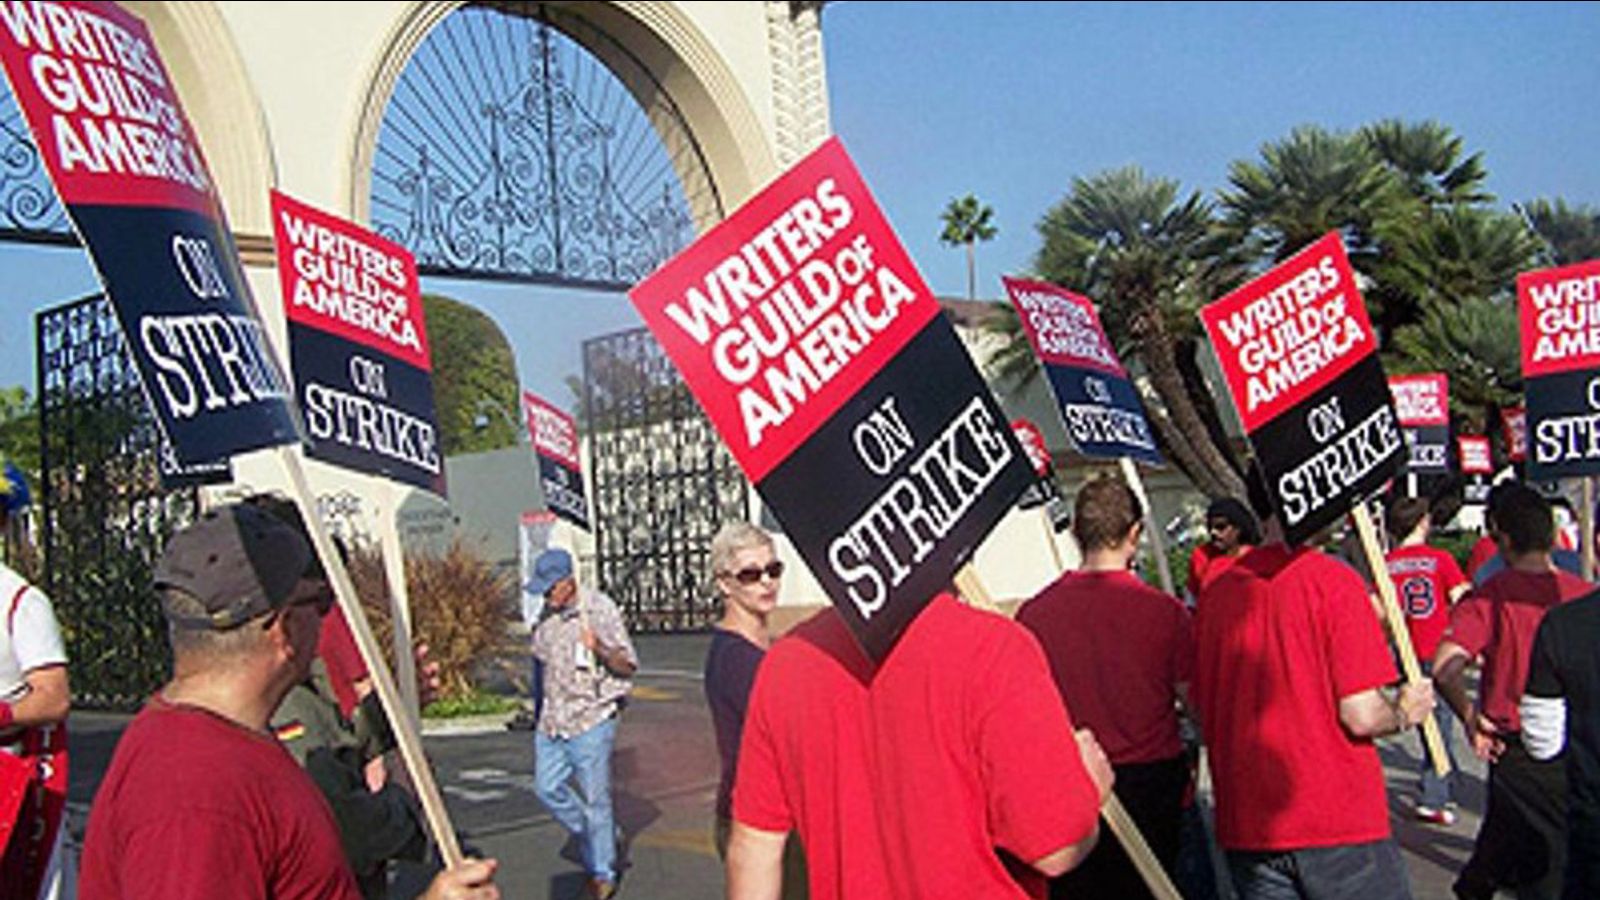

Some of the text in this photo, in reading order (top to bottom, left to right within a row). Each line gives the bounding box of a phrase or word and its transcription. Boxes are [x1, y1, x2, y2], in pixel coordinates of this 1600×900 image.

[282, 210, 407, 289] WRITERS
[292, 247, 382, 303] GUILD
[664, 178, 855, 346] WRITERS
[293, 280, 423, 354] AMERICA
[711, 259, 841, 383] GUILD
[1217, 256, 1341, 347] WRITERS
[1528, 275, 1600, 311] WRI
[1537, 299, 1600, 335] GUI
[349, 355, 388, 399] ON
[737, 265, 916, 448] AMERICA
[1238, 307, 1321, 375] GUILD
[1246, 315, 1366, 413] AMERICA
[305, 383, 441, 475] STRIKE
[851, 396, 915, 475] ON
[1307, 396, 1347, 444] ON
[1278, 404, 1402, 525] STRIKE
[827, 396, 1012, 620] STRIKE
